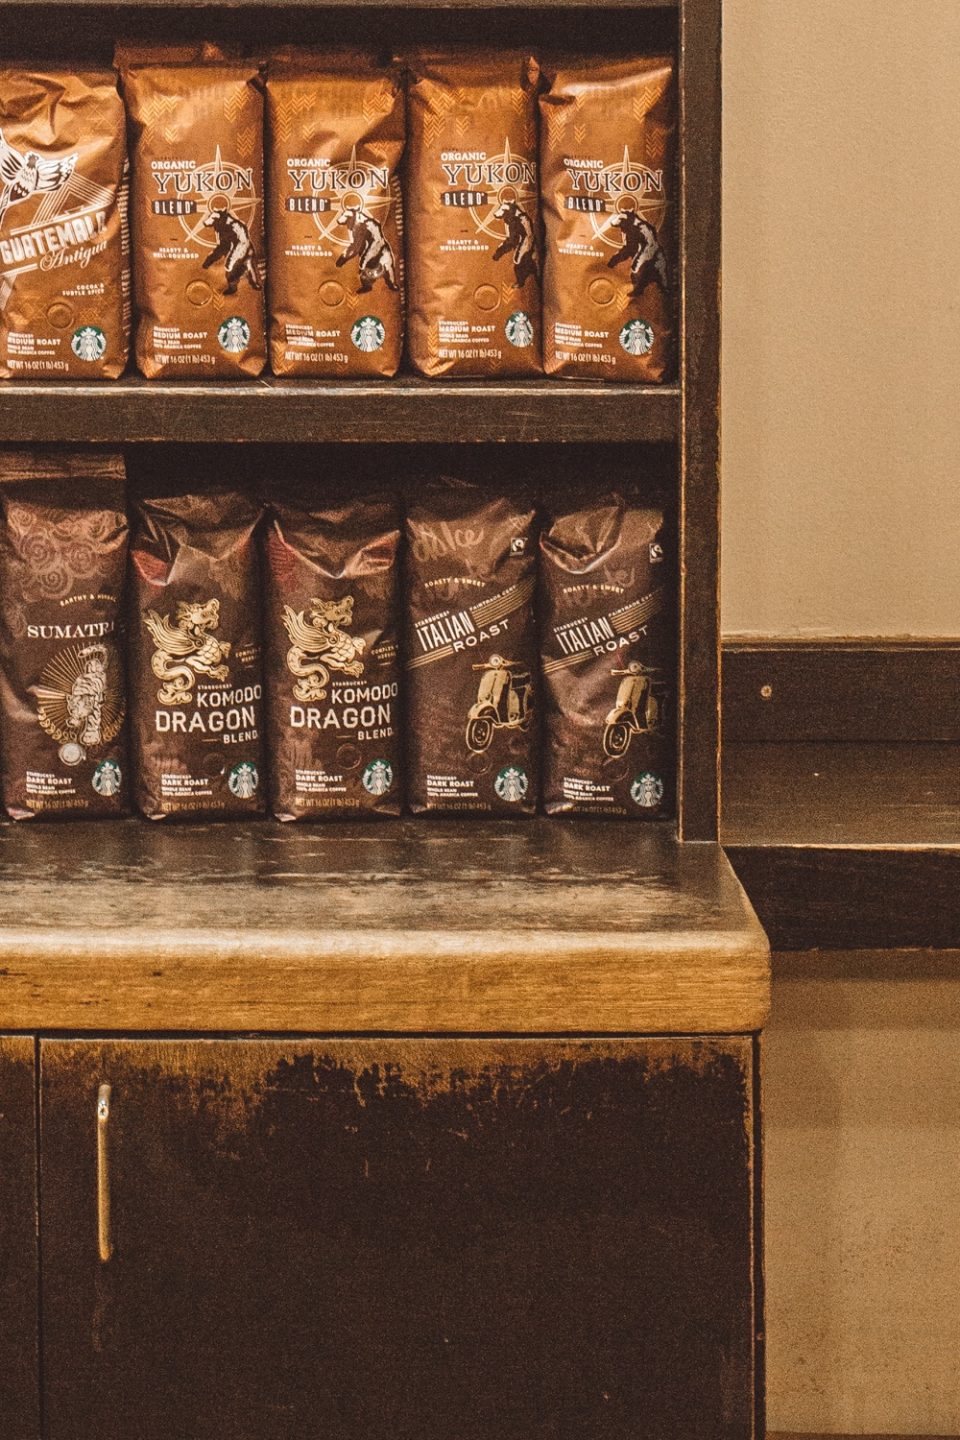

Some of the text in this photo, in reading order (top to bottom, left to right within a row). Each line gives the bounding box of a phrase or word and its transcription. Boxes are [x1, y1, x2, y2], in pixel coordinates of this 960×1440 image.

[151, 161, 196, 170] ORGANIC
[287, 158, 331, 167] ORGANIC
[440, 152, 486, 161] ORGANIC
[563, 158, 603, 169] ORGANIC
[151, 169, 253, 194] YUKON
[287, 169, 389, 191] YUKON
[442, 162, 536, 185] YUKON
[566, 169, 663, 193] YUKON
[153, 200, 192, 214] BLEND
[289, 199, 326, 212] BLEND
[444, 193, 483, 206] BLEND
[0, 211, 108, 264] GUATEMALA
[39, 239, 108, 271] Antigua
[27, 621, 114, 639] SUMATR
[415, 610, 476, 652] ITALIAN
[452, 619, 510, 653] ROAST
[555, 616, 615, 655] ITALIAN
[593, 625, 648, 656] ROAST
[197, 683, 262, 708] KOMODO
[331, 682, 398, 704] KOMODO
[156, 705, 256, 733] DRAGON
[290, 705, 391, 729] DRAGON
[223, 730, 258, 744] BLEND
[357, 727, 393, 741] BLEND
[162, 778, 208, 786] DARK ROAST
